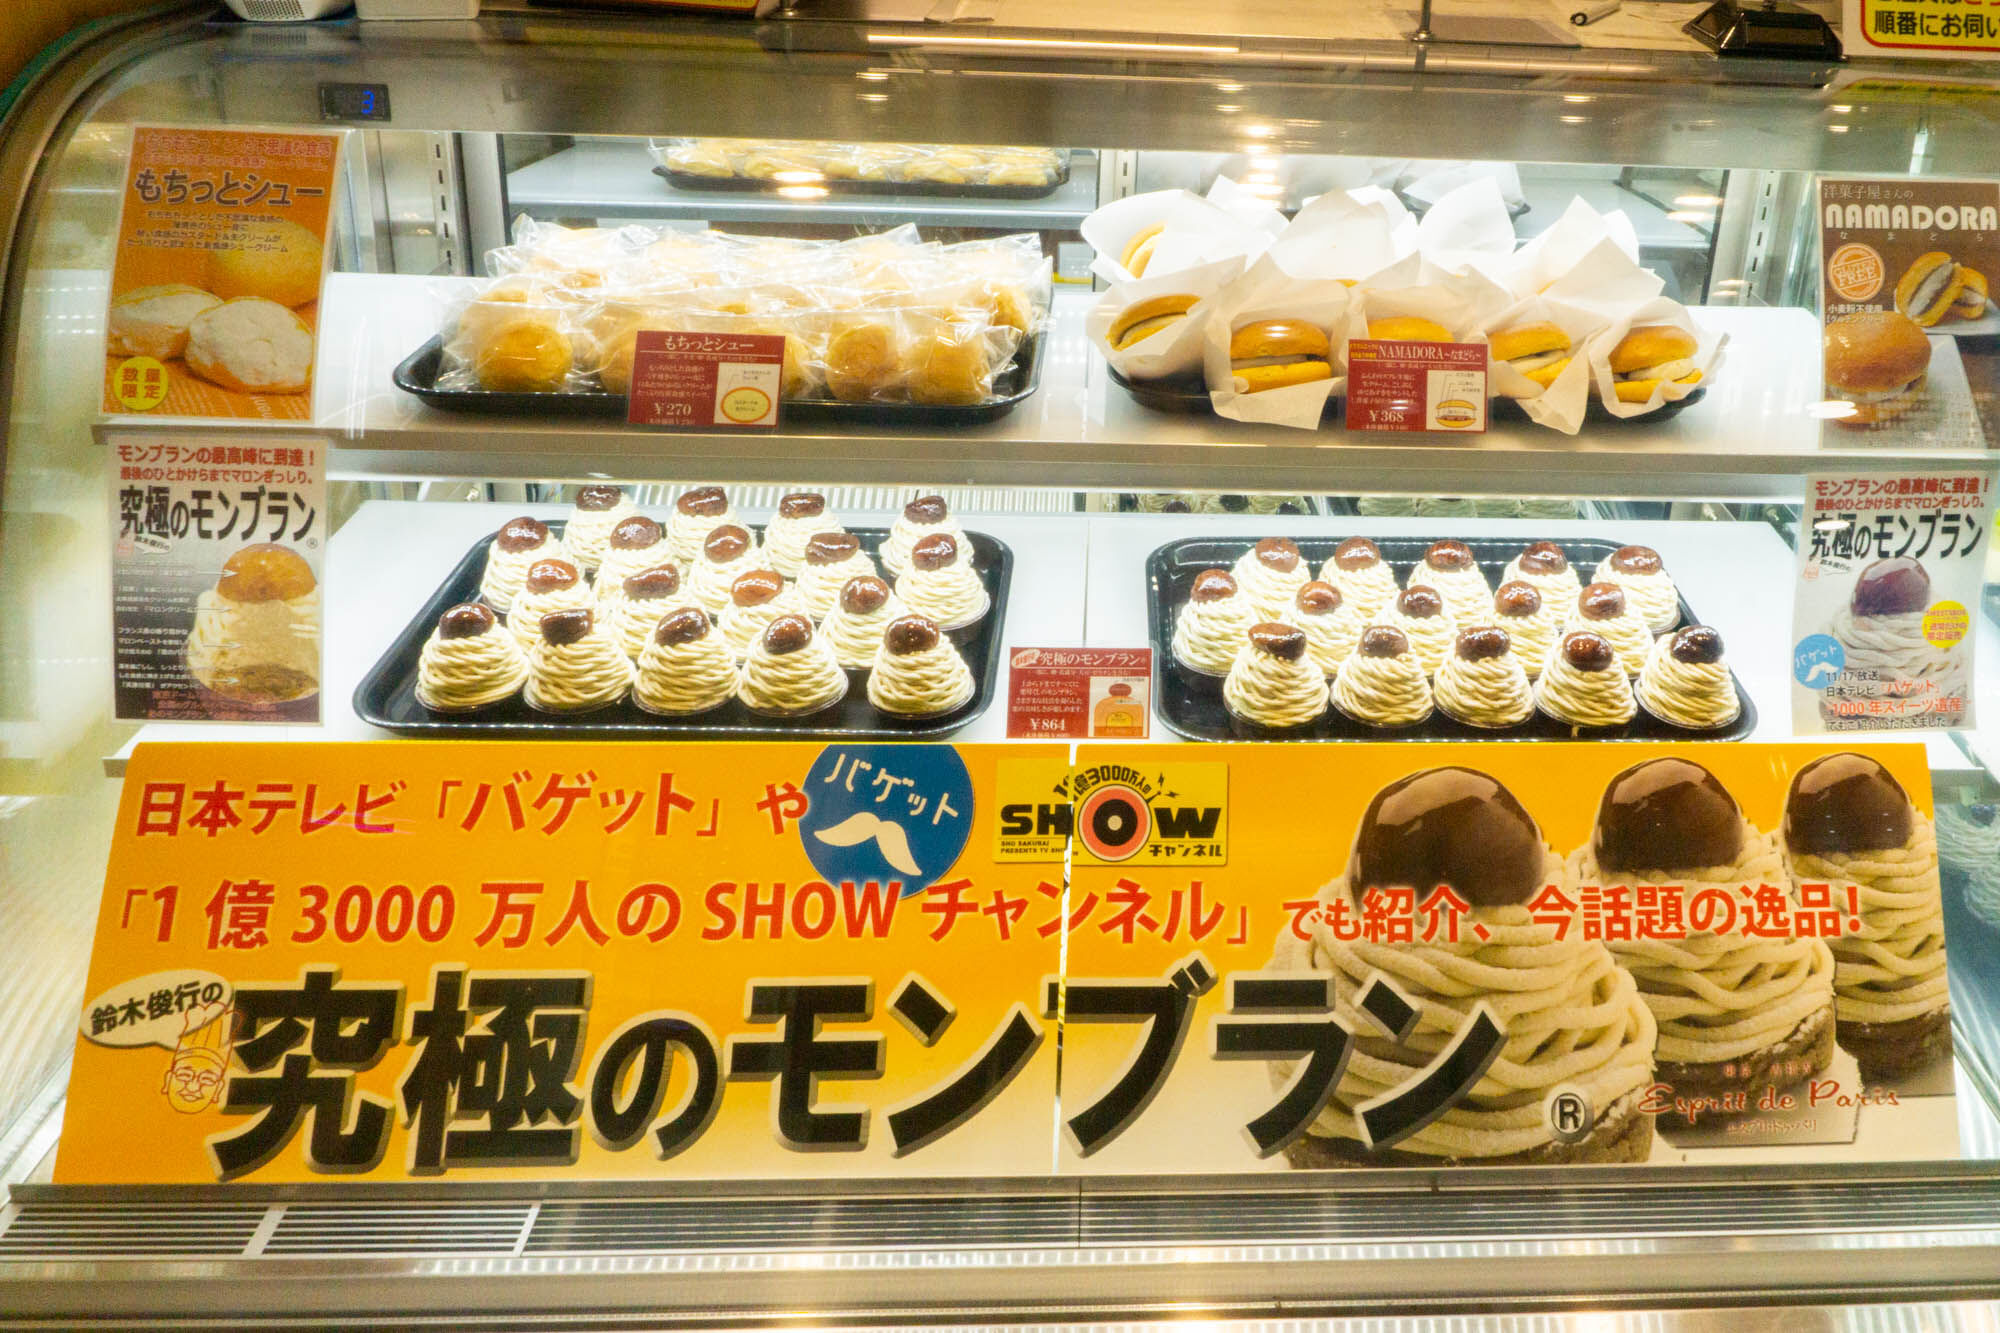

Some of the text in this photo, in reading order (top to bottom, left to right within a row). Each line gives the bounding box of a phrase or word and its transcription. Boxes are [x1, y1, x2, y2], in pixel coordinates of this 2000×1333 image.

[1874, 10, 2000, 38] 順番にお伺い
[136, 169, 324, 207] もちっとシュー
[1824, 184, 1914, 200] 洋菓子屋さんの
[1825, 203, 1998, 231] NAMADORA
[1838, 265, 1877, 288] FREE
[665, 335, 755, 351] もちっとシュー
[1378, 344, 1444, 361] NAMADORA
[654, 402, 692, 417] ¥270
[1369, 409, 1405, 423] ¥368
[118, 445, 315, 467] モンブランの最高峰に到達!
[120, 466, 313, 485] 最後のひとかけらまでマロンぎっしり。
[1816, 477, 1989, 496] モンブランの最高峰に到達!
[120, 485, 316, 543] 究極のモンブラン
[1815, 496, 1984, 511] 最後のひとかけらまでマロンぎっしり。
[1809, 509, 1983, 560] 究極のモンブラン
[1030, 718, 1066, 731] ¥864
[824, 753, 959, 825] バゲット
[1149, 844, 1222, 858] チャンネル
[91, 980, 224, 1036] 鈴木俊行の
[208, 956, 1509, 1180] 究極のモンブラン
[1638, 1079, 1901, 1124] Esprit de Paris
